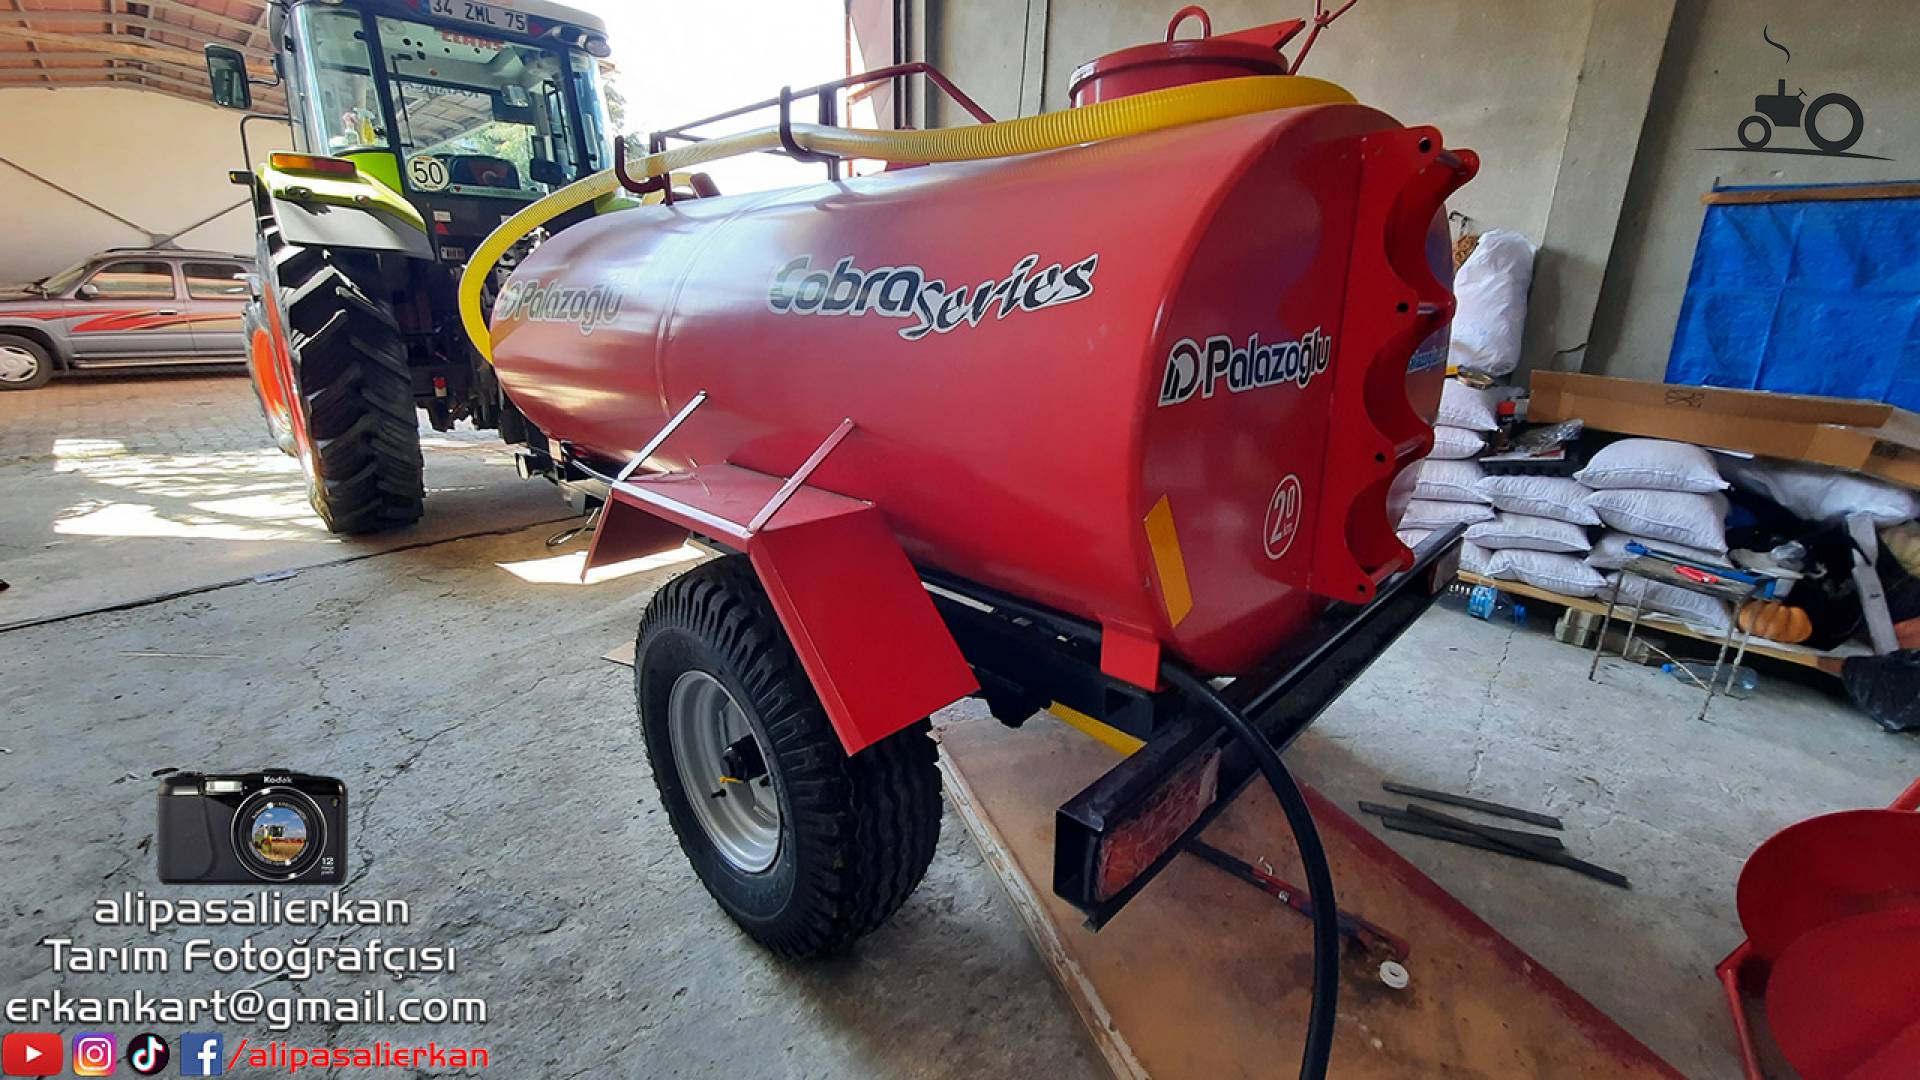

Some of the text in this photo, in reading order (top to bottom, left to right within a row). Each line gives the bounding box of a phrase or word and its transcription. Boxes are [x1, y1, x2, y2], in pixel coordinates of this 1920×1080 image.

[433, 0, 527, 31] 34 ZML 75
[413, 161, 443, 184] 50
[769, 254, 924, 315] Cobra
[1269, 485, 1296, 544] 20
